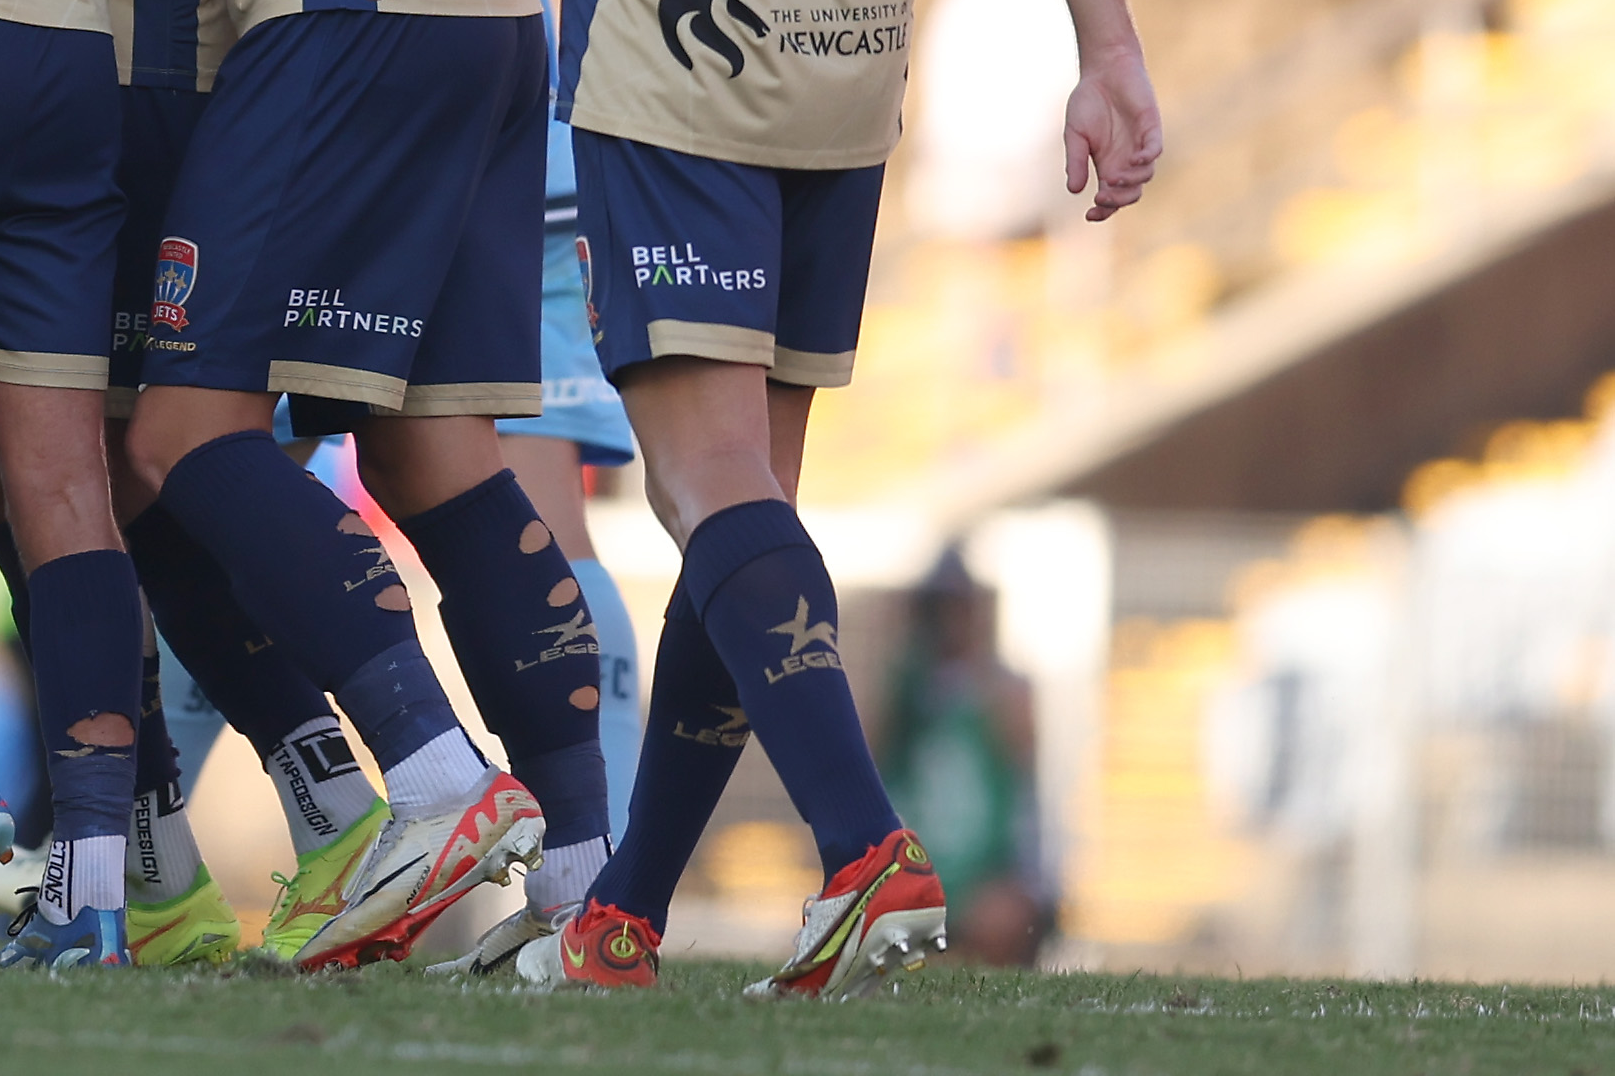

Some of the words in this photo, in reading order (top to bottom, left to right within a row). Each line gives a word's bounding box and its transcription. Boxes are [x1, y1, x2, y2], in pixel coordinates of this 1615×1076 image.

[771, 9, 801, 23] THE
[811, 4, 897, 23] UNIVERSITY
[632, 242, 701, 266] BELL
[288, 288, 345, 307] BELL
[154, 305, 178, 322] JETS
[284, 307, 423, 338] PARTNERS
[154, 339, 196, 352] LEGEND
[275, 749, 339, 836] TAPEDESIGN
